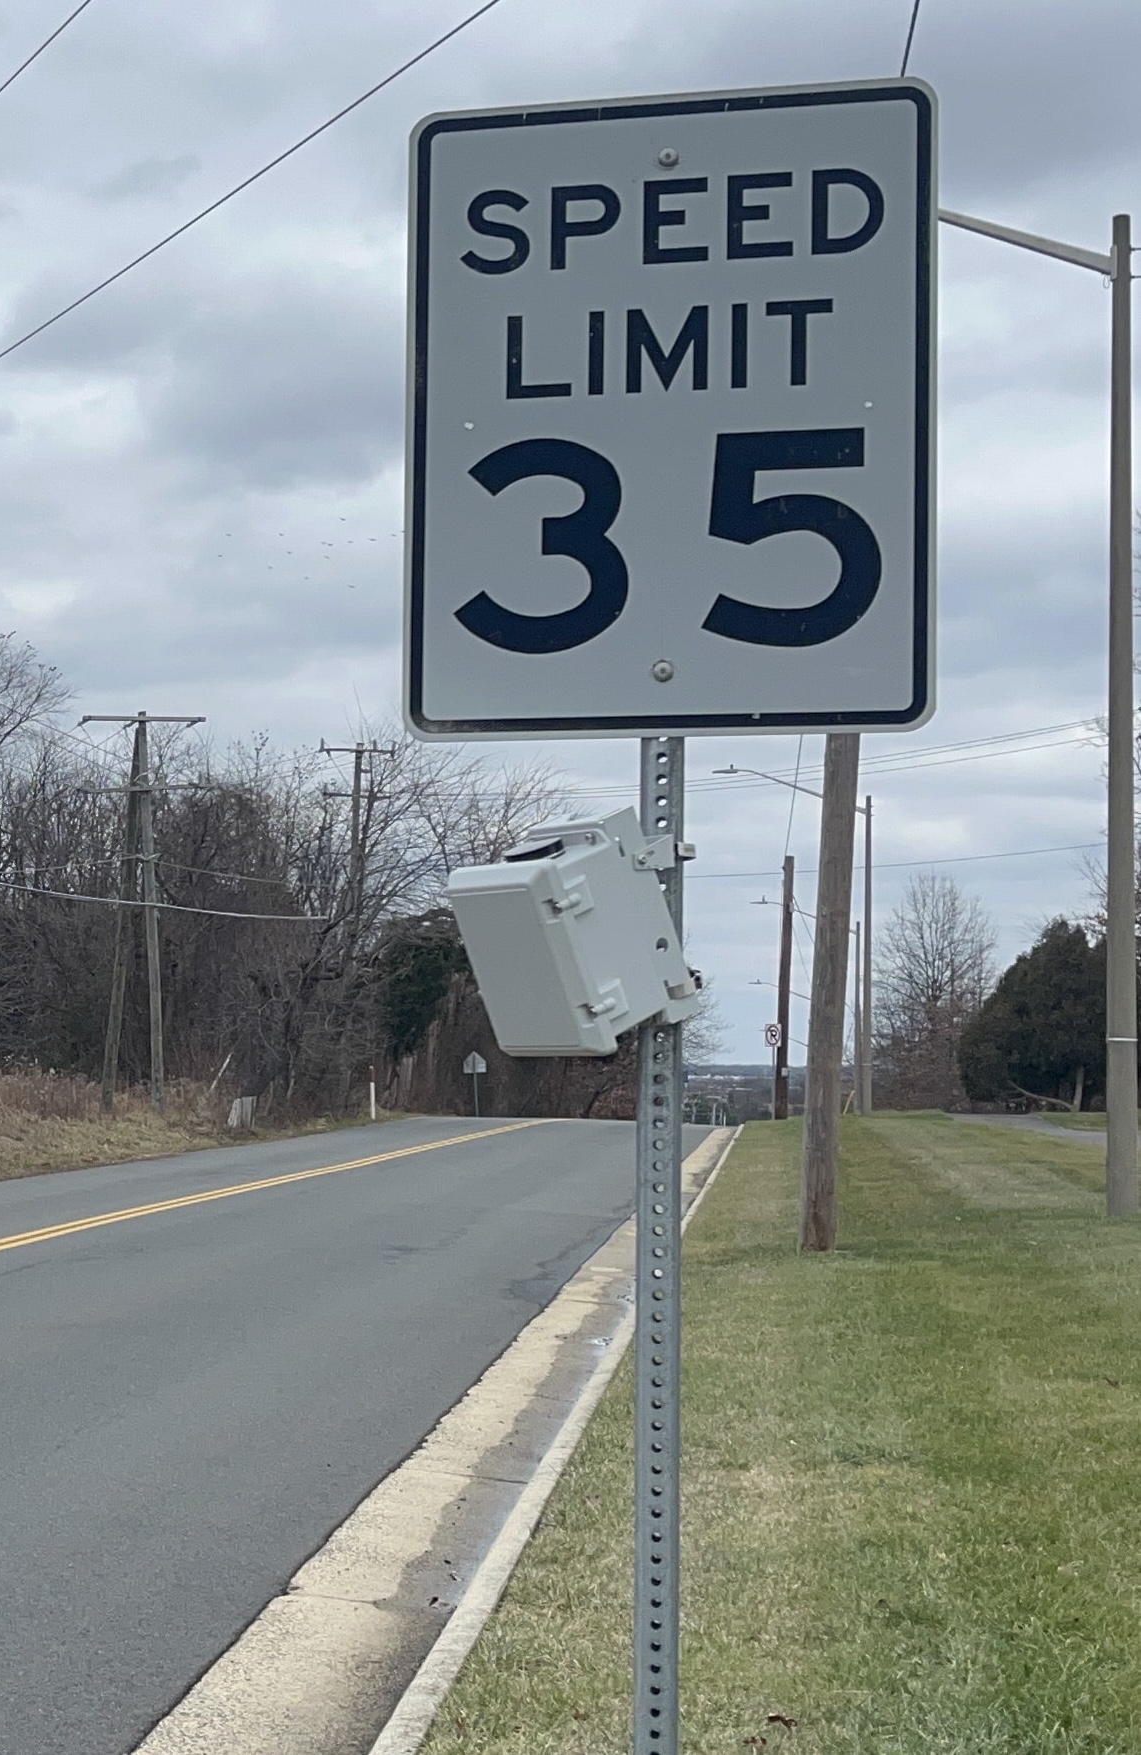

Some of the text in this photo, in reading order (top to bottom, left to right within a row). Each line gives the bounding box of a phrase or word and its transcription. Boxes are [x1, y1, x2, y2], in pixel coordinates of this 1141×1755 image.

[460, 168, 884, 275] SPEED
[506, 298, 834, 399] LIMIT
[453, 427, 882, 654] 35
